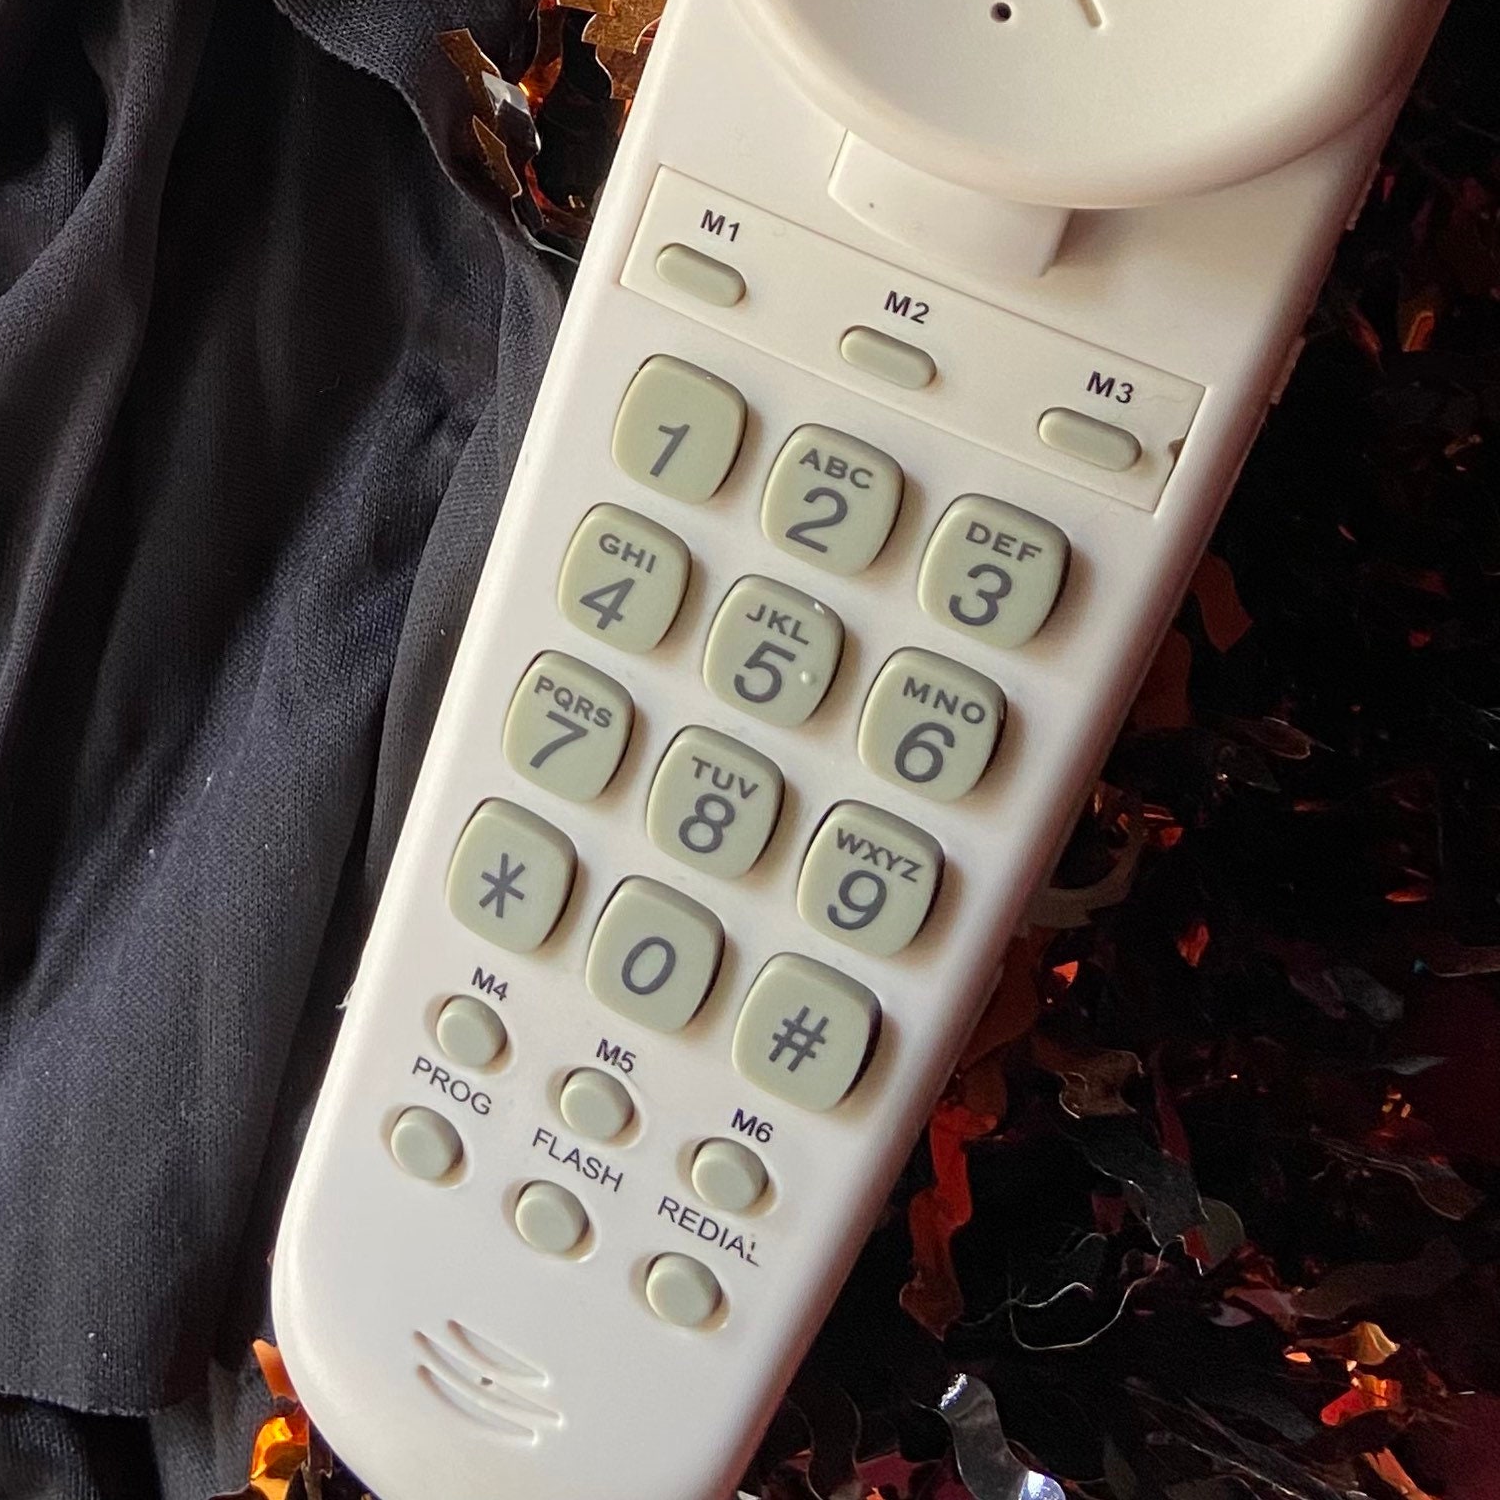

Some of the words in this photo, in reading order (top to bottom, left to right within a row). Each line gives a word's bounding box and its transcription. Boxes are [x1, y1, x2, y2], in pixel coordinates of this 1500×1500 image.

[700, 209, 740, 243] M1
[883, 290, 930, 325] M2
[1086, 370, 1134, 404] M3
[649, 423, 691, 478] 1
[798, 447, 874, 490] ABC
[785, 486, 849, 554] 2
[965, 520, 1043, 562] DEF
[598, 533, 657, 574] GHI
[578, 577, 636, 631] 4
[948, 563, 1013, 627] 3
[745, 604, 810, 646] JKL
[733, 640, 797, 704] 5
[533, 674, 613, 729] PQRS
[902, 676, 987, 725] MNO
[529, 710, 589, 770] 7
[894, 721, 956, 784] 6
[691, 755, 760, 800] TUV
[678, 792, 737, 855] 8
[836, 828, 922, 884] WXYZ
[827, 869, 888, 931] 9
[471, 966, 509, 1003] M4
[621, 936, 677, 996] 0
[596, 1038, 637, 1076] M5
[768, 1005, 828, 1073] #
[411, 1055, 493, 1116] PROG
[731, 1108, 774, 1144] M6
[531, 1127, 624, 1193] FLASH
[657, 1195, 760, 1268] REDIAL
